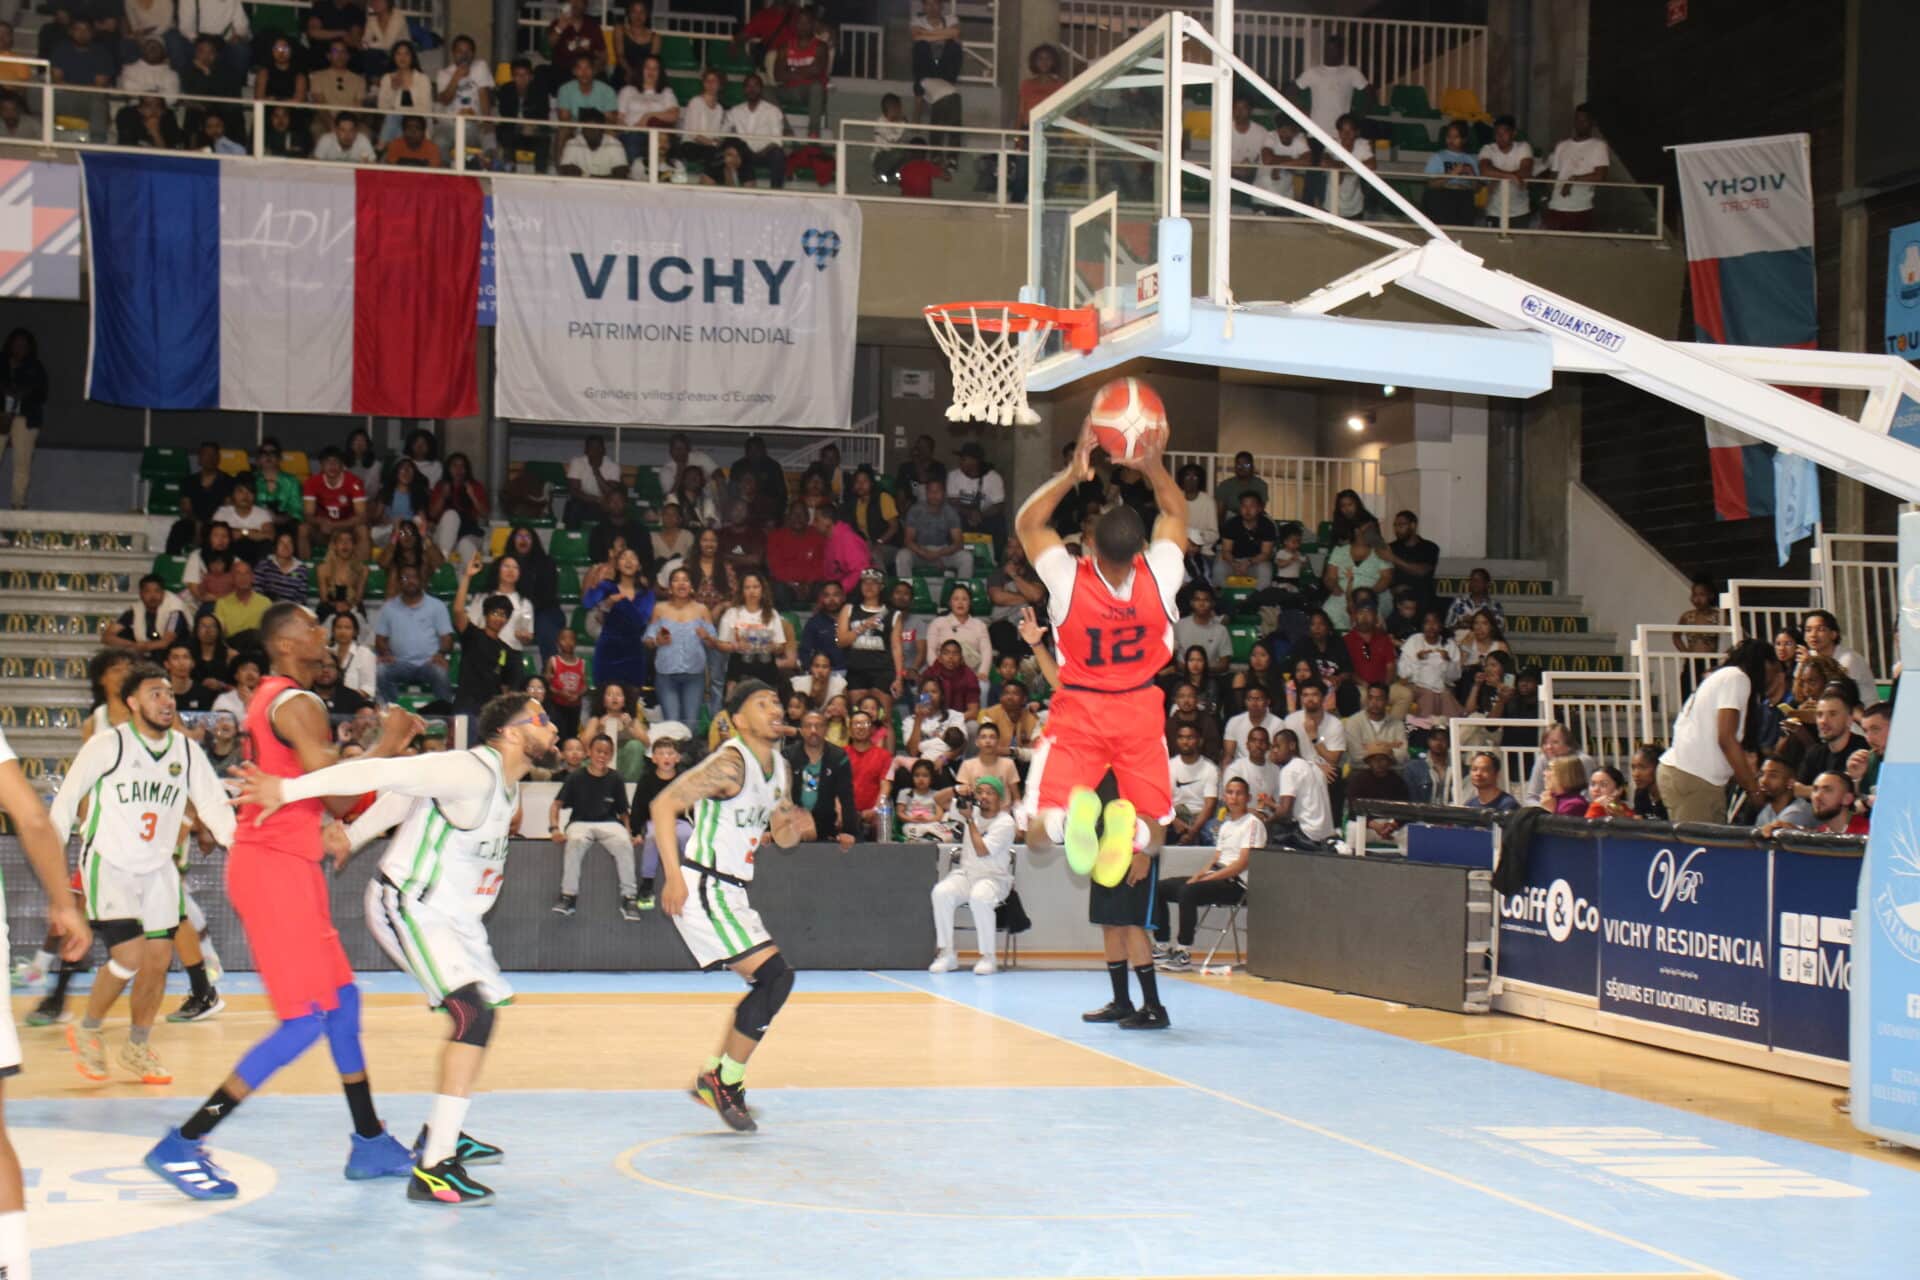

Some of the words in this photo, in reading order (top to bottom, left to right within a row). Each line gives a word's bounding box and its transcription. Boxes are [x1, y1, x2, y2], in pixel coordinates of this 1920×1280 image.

[570, 252, 795, 306] VICHY
[568, 321, 693, 342] PATRIMOINE
[700, 326, 795, 345] MONDIAL
[1541, 305, 1622, 348] NOUANSPORT
[583, 386, 638, 401] Grandes
[1085, 626, 1145, 667] 12
[139, 812, 158, 842] 3
[1603, 918, 1652, 949] VICHY
[1656, 926, 1765, 969] RESIDENCIA
[1605, 977, 1642, 1003] SÉJOURS
[1643, 988, 1656, 1006] ET
[1656, 990, 1707, 1016] LOCATIONS
[1708, 1001, 1760, 1027] MEUBLÉES
